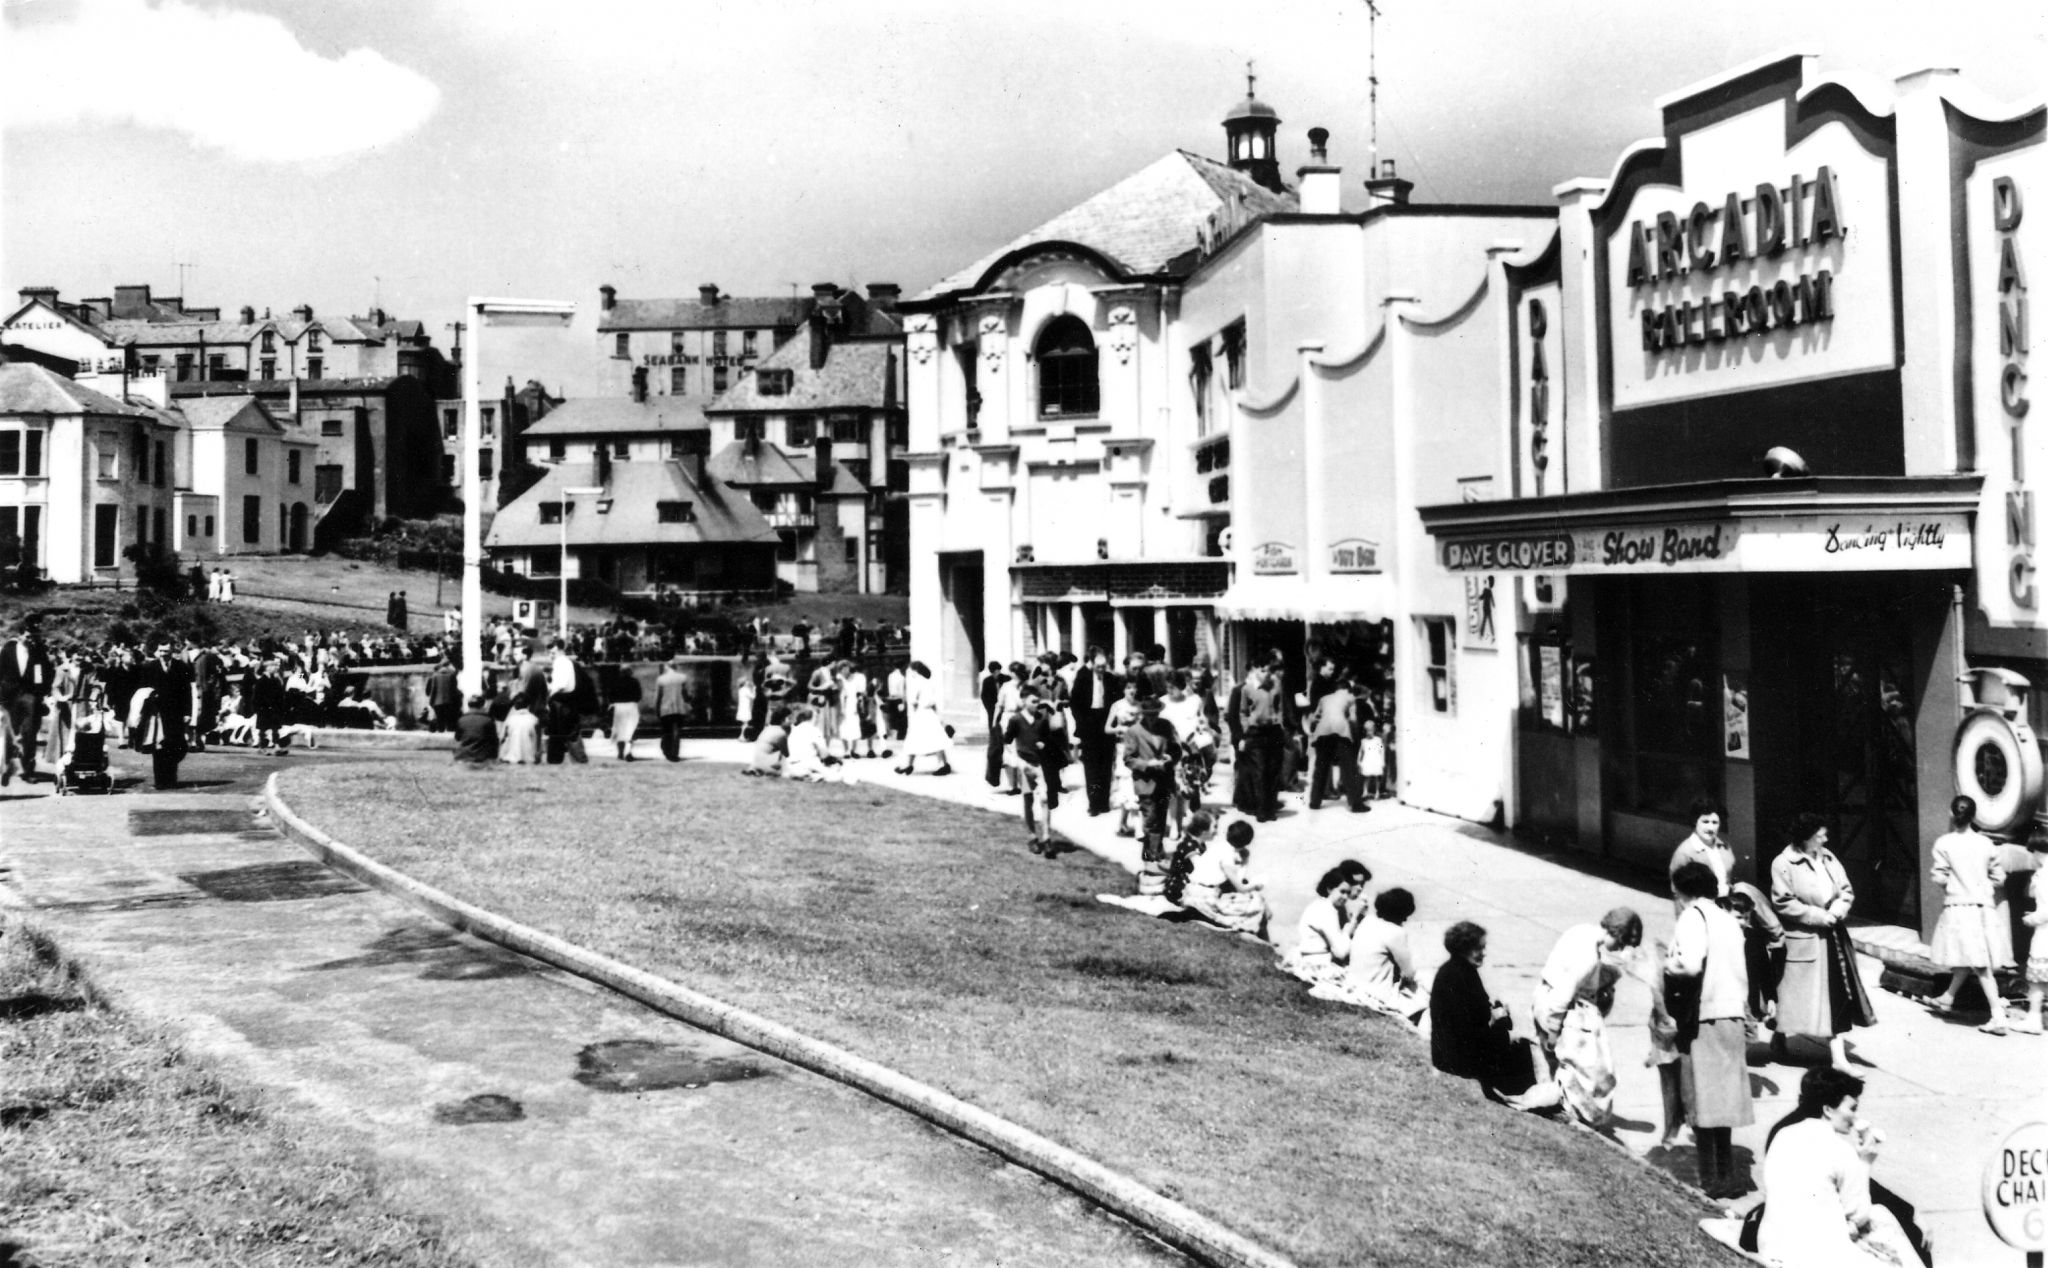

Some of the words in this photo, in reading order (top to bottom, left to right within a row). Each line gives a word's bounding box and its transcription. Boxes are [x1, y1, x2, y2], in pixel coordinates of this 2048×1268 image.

[1627, 165, 1846, 287] ARCADIA
[1641, 270, 1834, 353] BALLROOM
[643, 354, 699, 366] SEABANK
[1993, 176, 2037, 612] DANCING
[1529, 298, 1553, 603] DANCIG
[1449, 543, 1493, 569] DAVE
[1497, 539, 1568, 569] GLOVER
[1603, 530, 1654, 565] Show
[1661, 524, 1721, 566] Band
[1825, 523, 1887, 553] Dancing
[2003, 1148, 2048, 1178] DEC
[1996, 1180, 2048, 1207] CHAI
